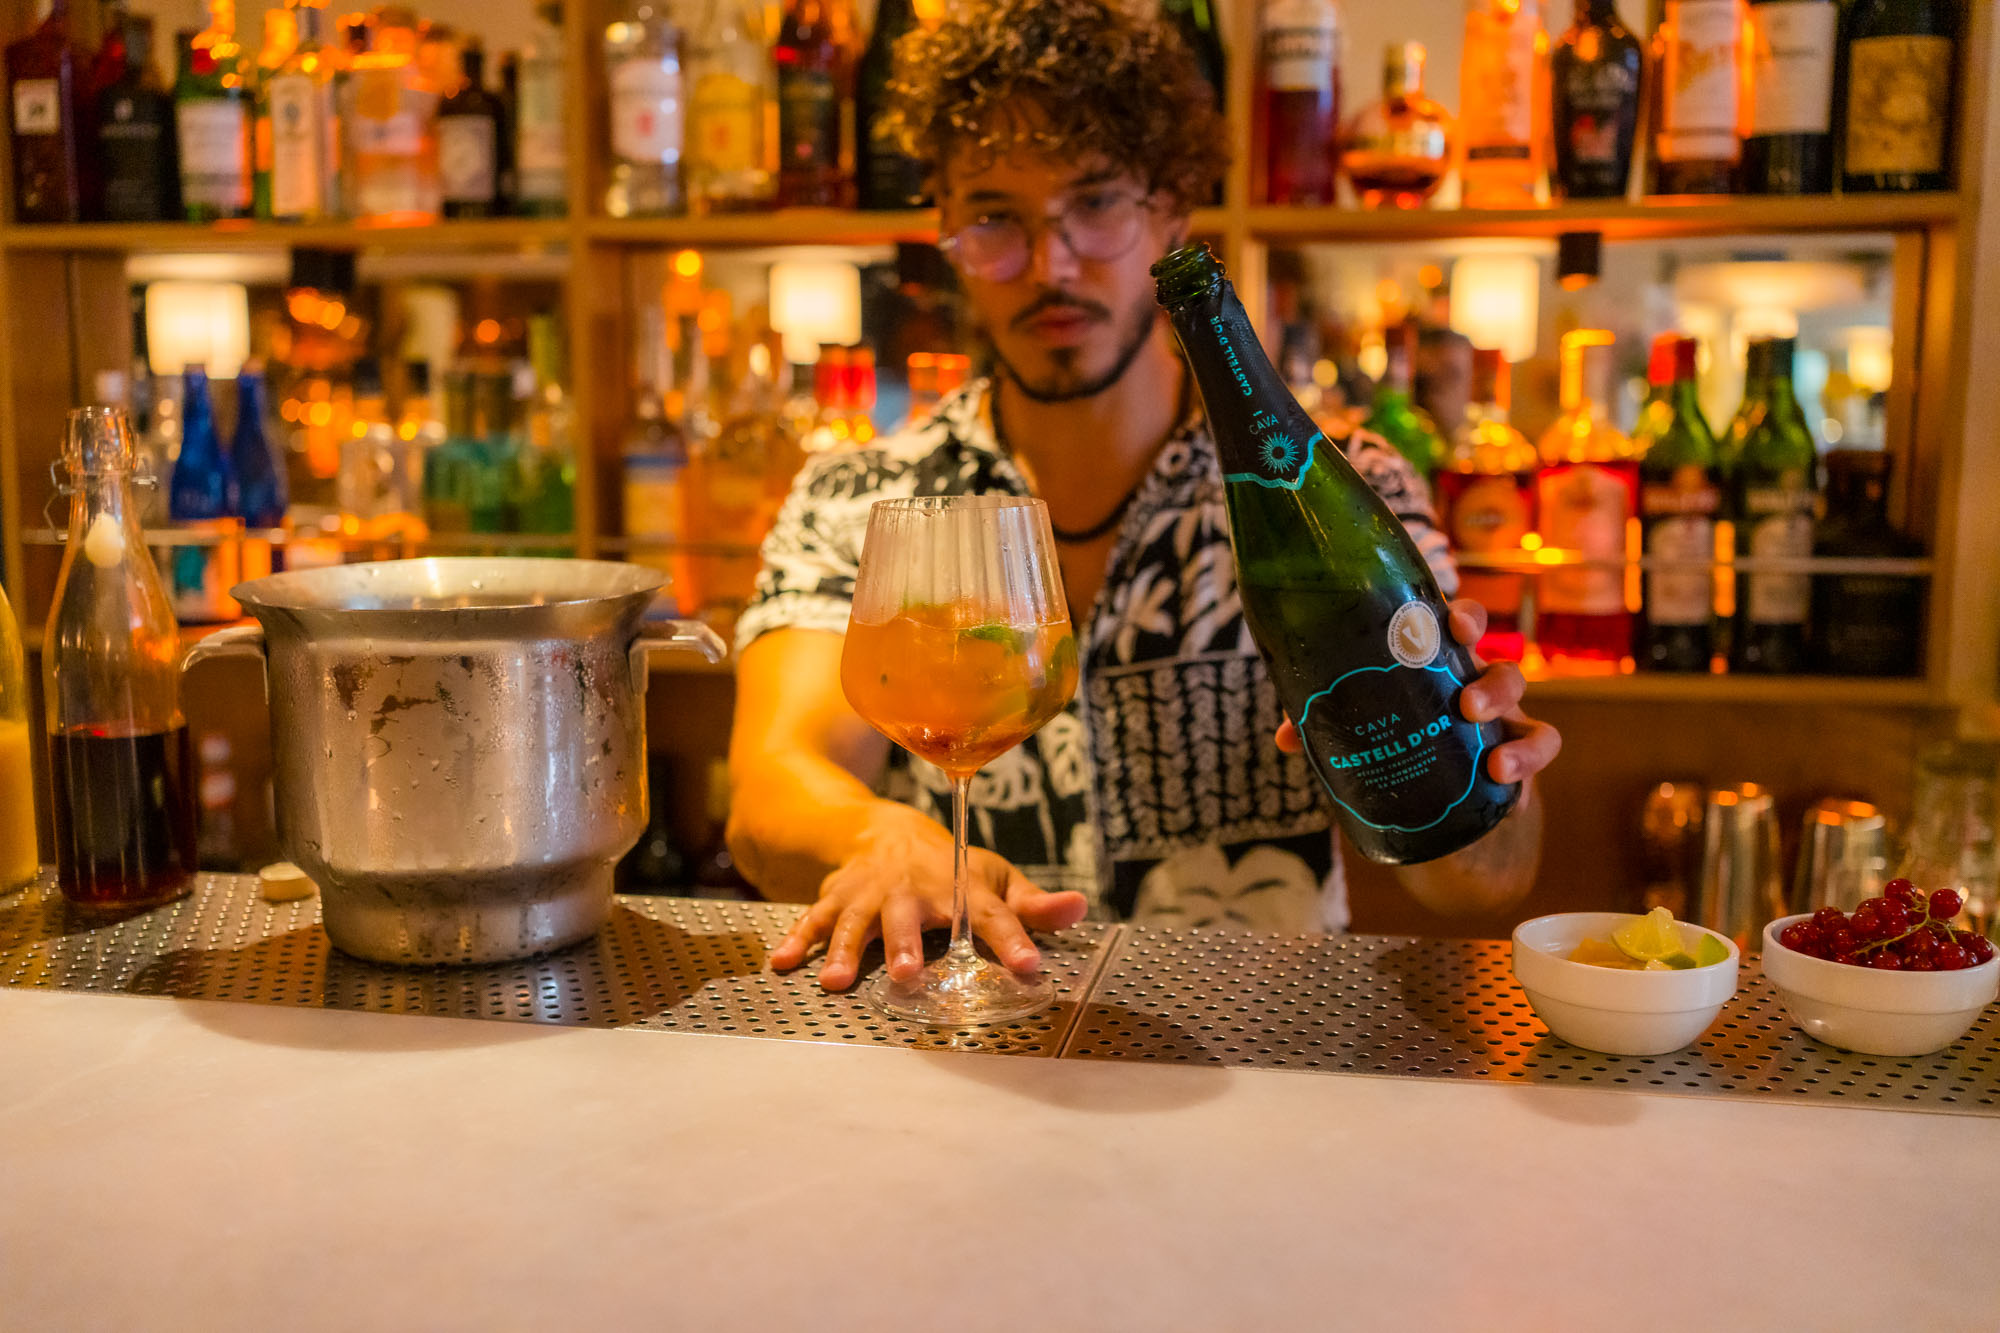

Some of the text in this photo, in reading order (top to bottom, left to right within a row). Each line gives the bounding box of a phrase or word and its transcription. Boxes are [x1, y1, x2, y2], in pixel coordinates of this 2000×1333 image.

[1223, 345, 1253, 396] CASTELL
[1249, 413, 1279, 435] CAVA
[1329, 714, 1452, 769] CASTELL D'OR
[1355, 713, 1401, 736] CAVA
